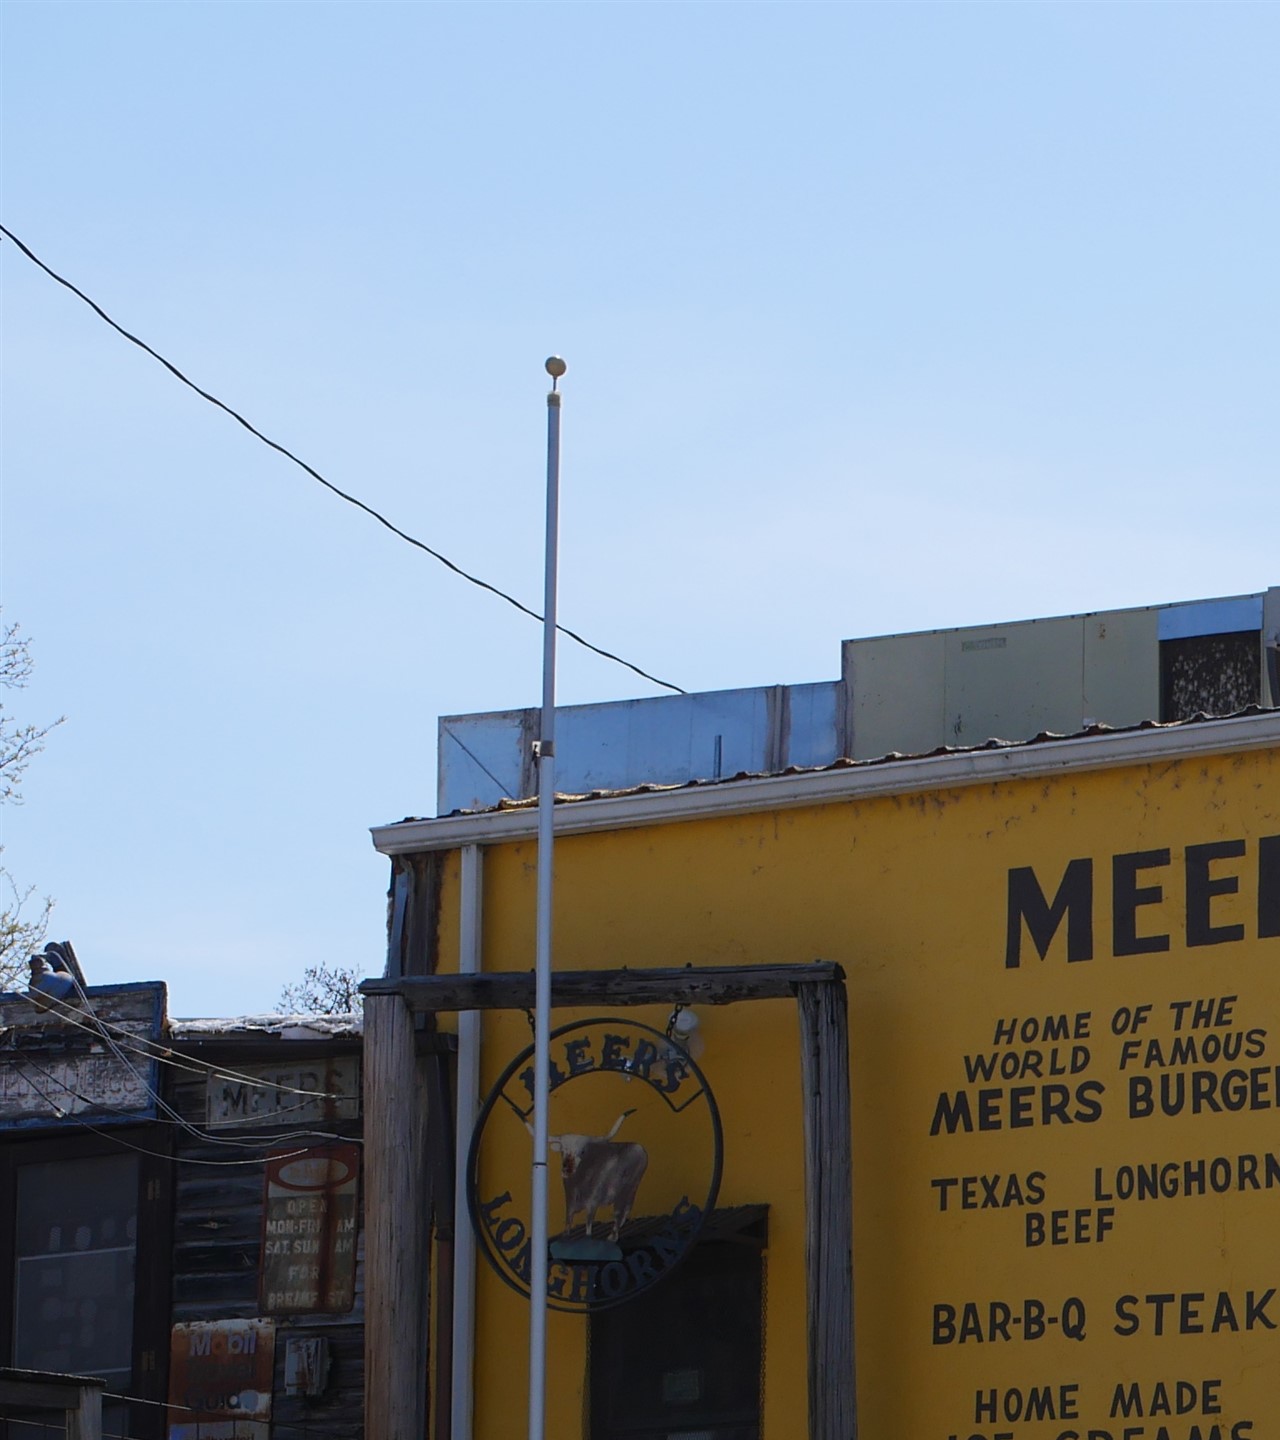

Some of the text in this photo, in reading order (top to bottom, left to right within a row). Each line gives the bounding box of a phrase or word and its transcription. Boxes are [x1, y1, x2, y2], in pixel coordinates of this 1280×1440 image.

[993, 995, 1237, 1045] HOME OF THE
[964, 1028, 1266, 1083] WORLD FAMOUS
[930, 1080, 1104, 1136] MEERS
[931, 1171, 1046, 1211] TEXAS
[1025, 1207, 1115, 1247] BEEF
[932, 1297, 1086, 1344] BAR-B-Q
[975, 1379, 1222, 1423] HOME MADE
